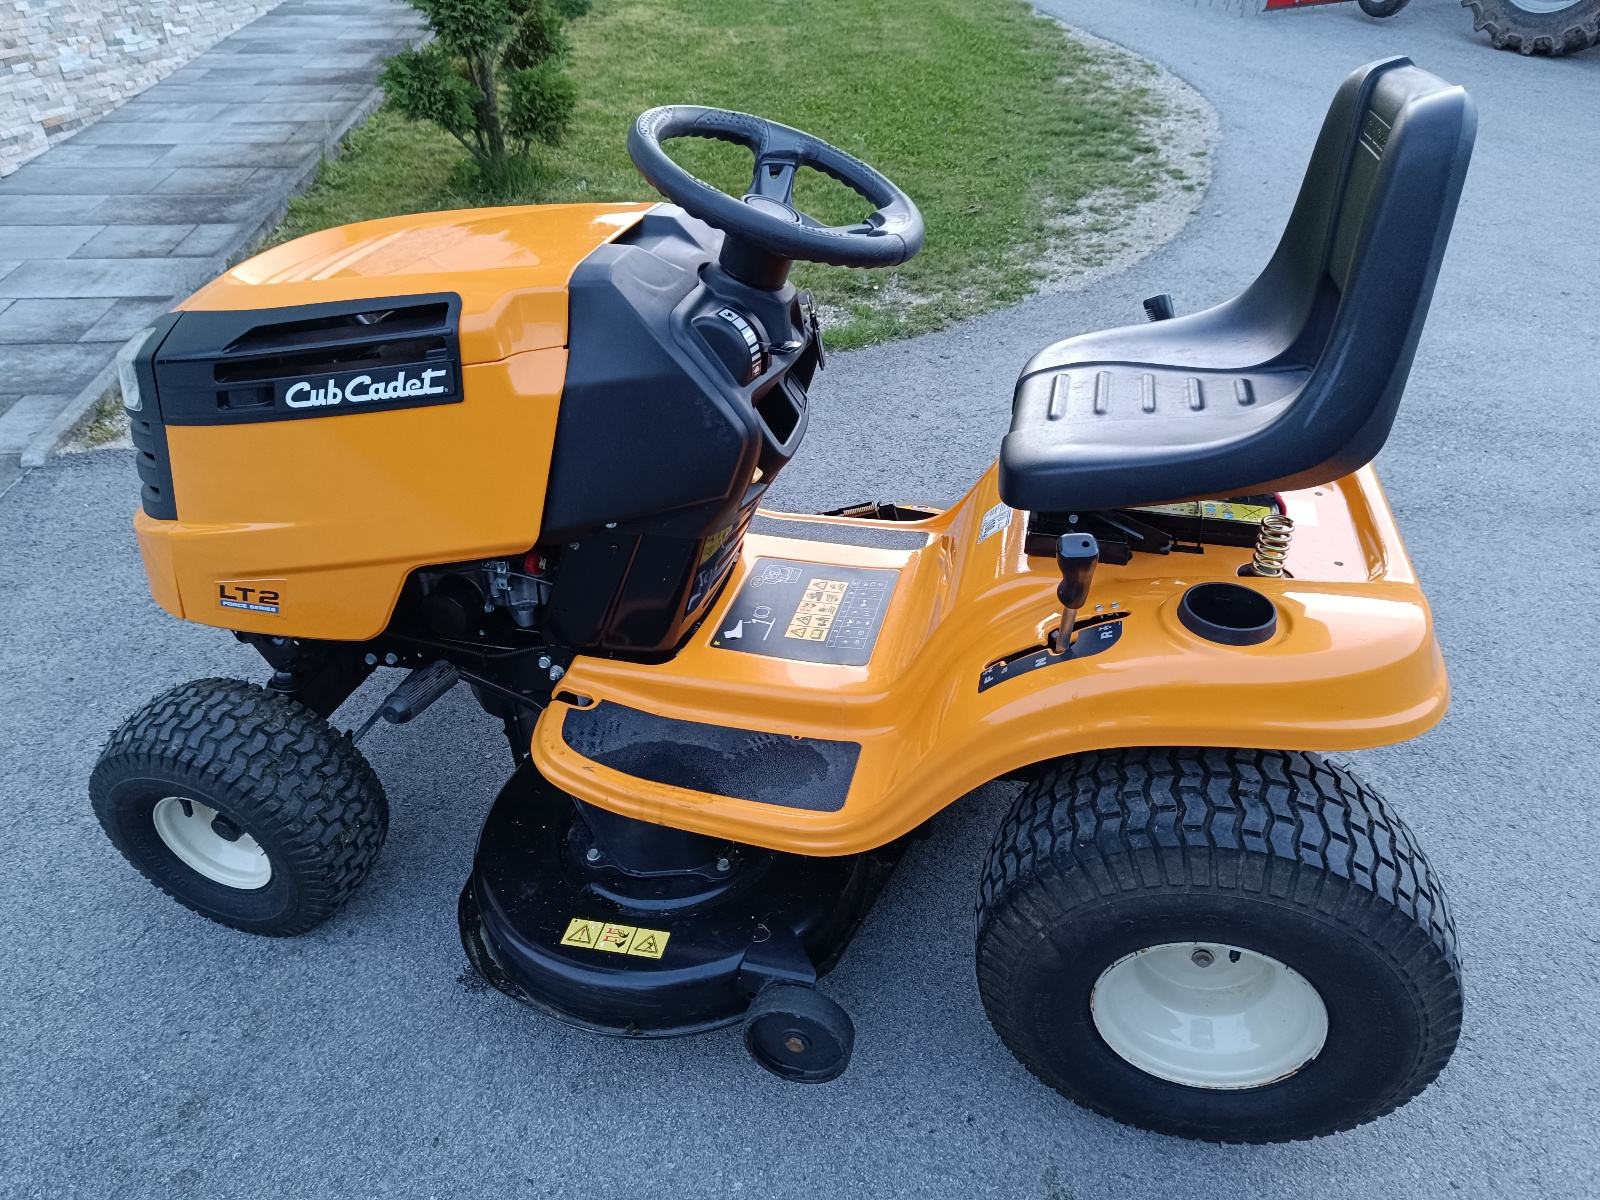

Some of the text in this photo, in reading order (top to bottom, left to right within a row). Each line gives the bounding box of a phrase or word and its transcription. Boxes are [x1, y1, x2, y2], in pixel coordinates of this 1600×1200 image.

[285, 369, 447, 408] Cub Cadet
[219, 585, 279, 605] LT2
[222, 600, 276, 613] FORCE SERIES
[1101, 630, 1113, 640] R
[1035, 656, 1047, 667] N
[983, 675, 994, 684] F
